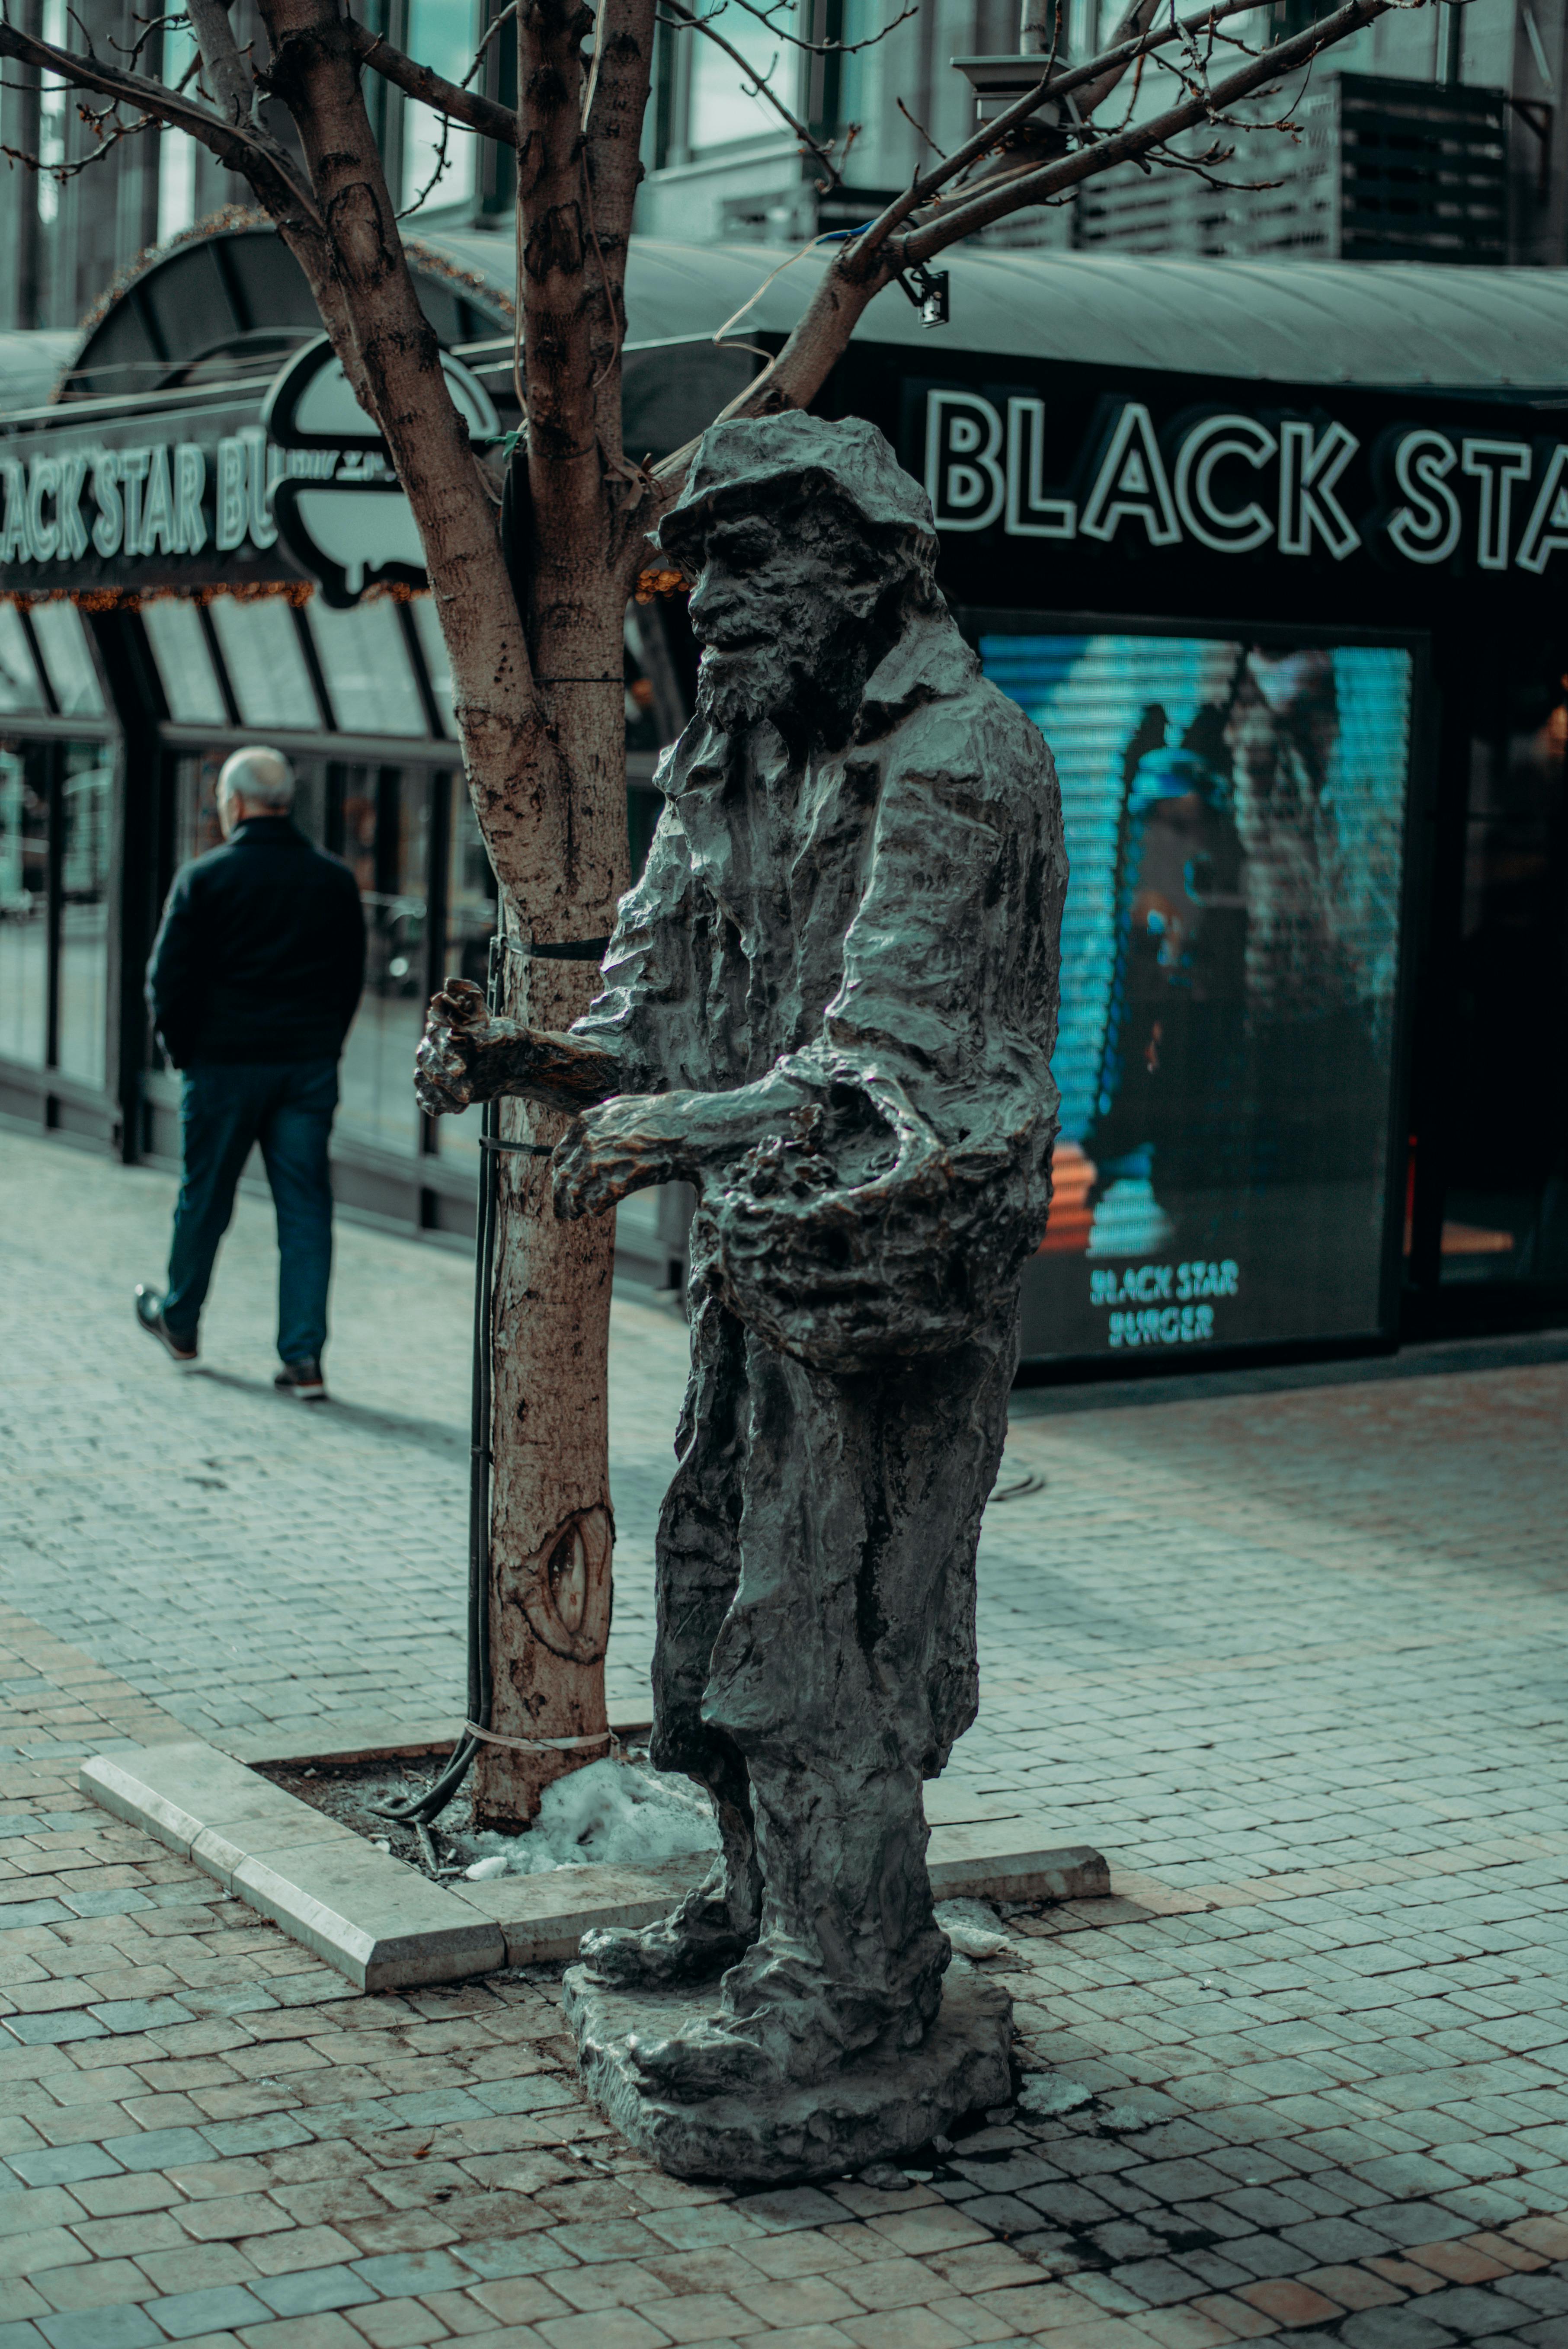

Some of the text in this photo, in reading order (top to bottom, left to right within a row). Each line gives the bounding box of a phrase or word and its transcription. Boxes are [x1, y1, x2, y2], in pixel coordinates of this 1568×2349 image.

[0, 453, 89, 564] ACK
[92, 441, 207, 558] STAR
[925, 388, 1362, 560] BLACK
[1090, 1259, 1239, 1306] BLACK STAR
[1108, 1304, 1214, 1347] BURGER
